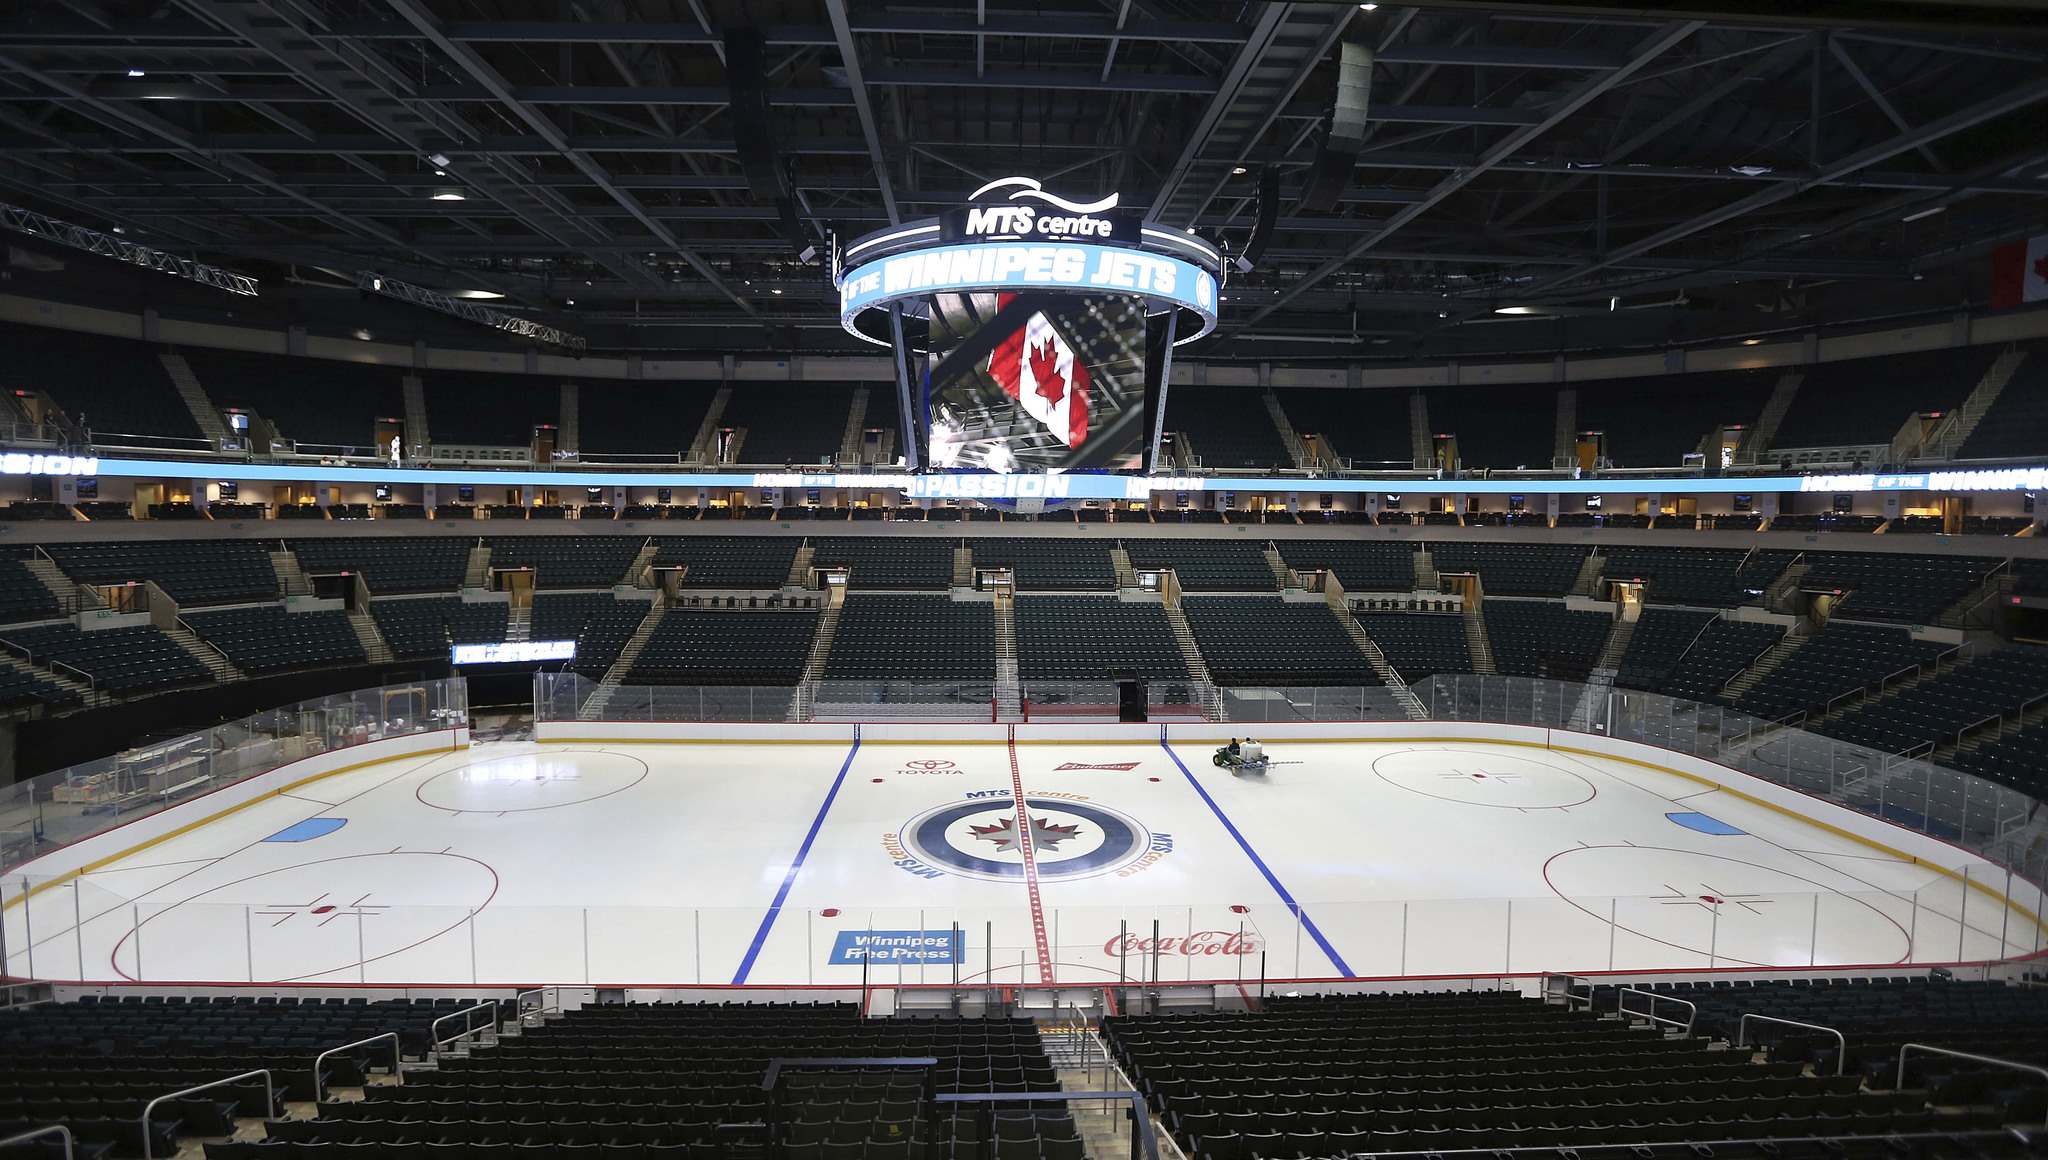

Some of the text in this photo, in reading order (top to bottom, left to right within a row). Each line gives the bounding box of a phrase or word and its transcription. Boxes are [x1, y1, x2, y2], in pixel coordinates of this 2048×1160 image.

[965, 206, 1113, 237] MTS centre
[884, 247, 1086, 293] WINNIPEG
[1091, 250, 1177, 294] JETS
[0, 454, 98, 476] SION
[926, 475, 1071, 498] PASSION
[1877, 477, 1898, 488] OF
[1899, 476, 1924, 487] THE
[966, 788, 1090, 801] MTS centre
[880, 832, 946, 879] MTS centre
[1115, 832, 1173, 878] MTS centre
[855, 935, 950, 948] Winnipeg
[844, 947, 951, 959] Free Press
